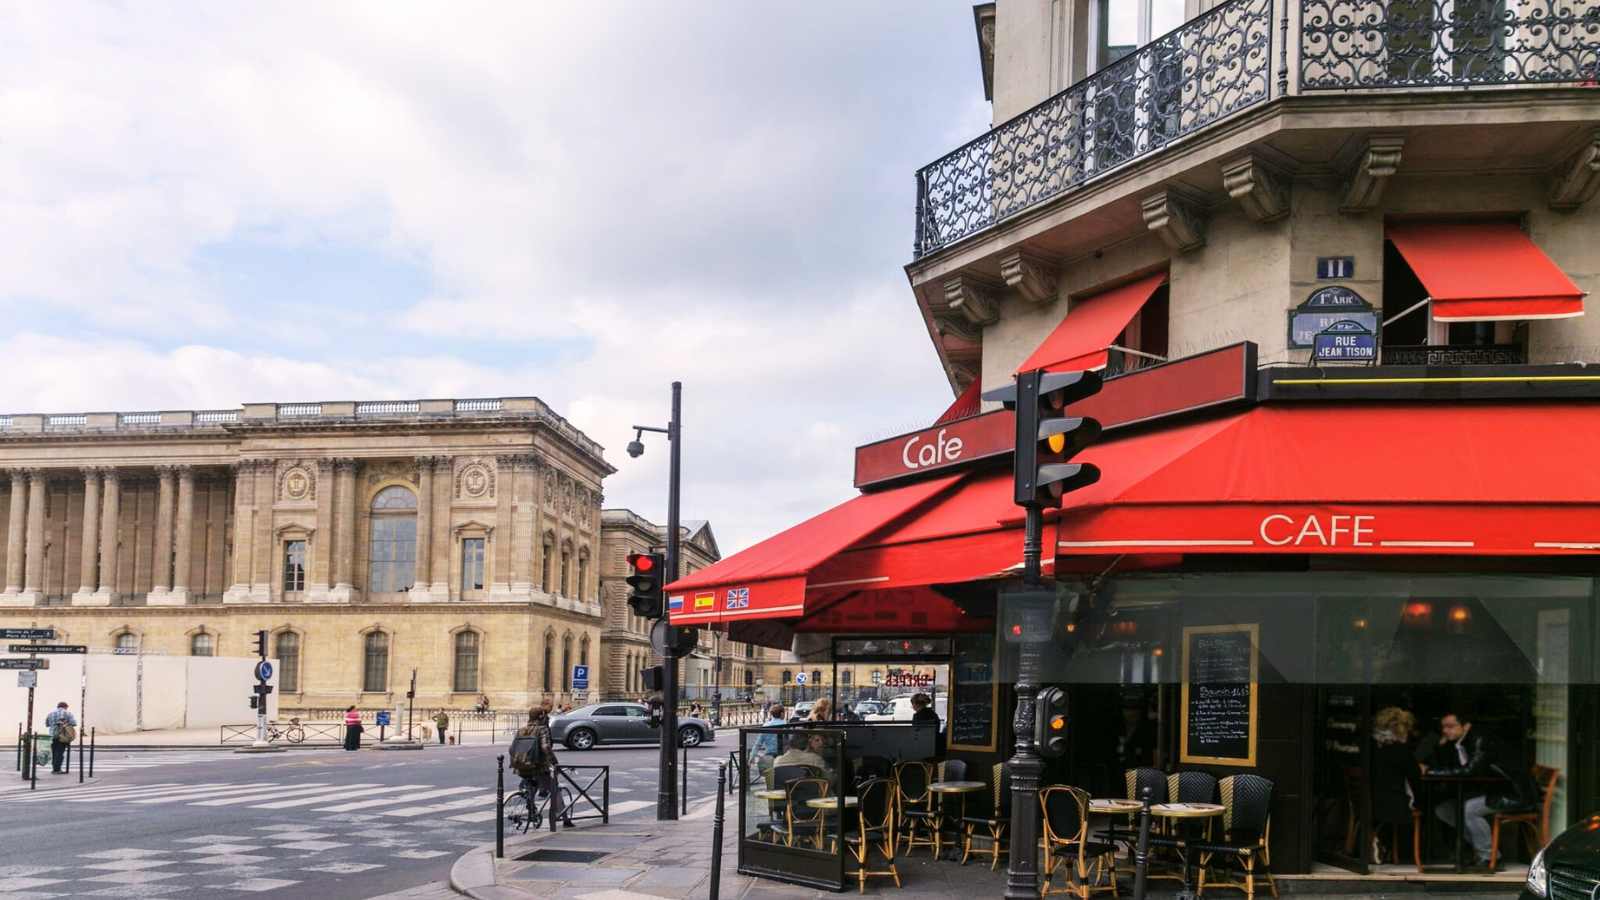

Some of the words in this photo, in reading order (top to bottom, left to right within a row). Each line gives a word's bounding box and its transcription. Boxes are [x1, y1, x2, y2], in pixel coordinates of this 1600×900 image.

[1327, 259, 1344, 277] 11
[1335, 336, 1356, 346] RUE
[1319, 347, 1342, 356] JEAN
[1346, 347, 1373, 356] TISON
[903, 428, 963, 469] Cafe
[1260, 514, 1375, 546] CAFE
